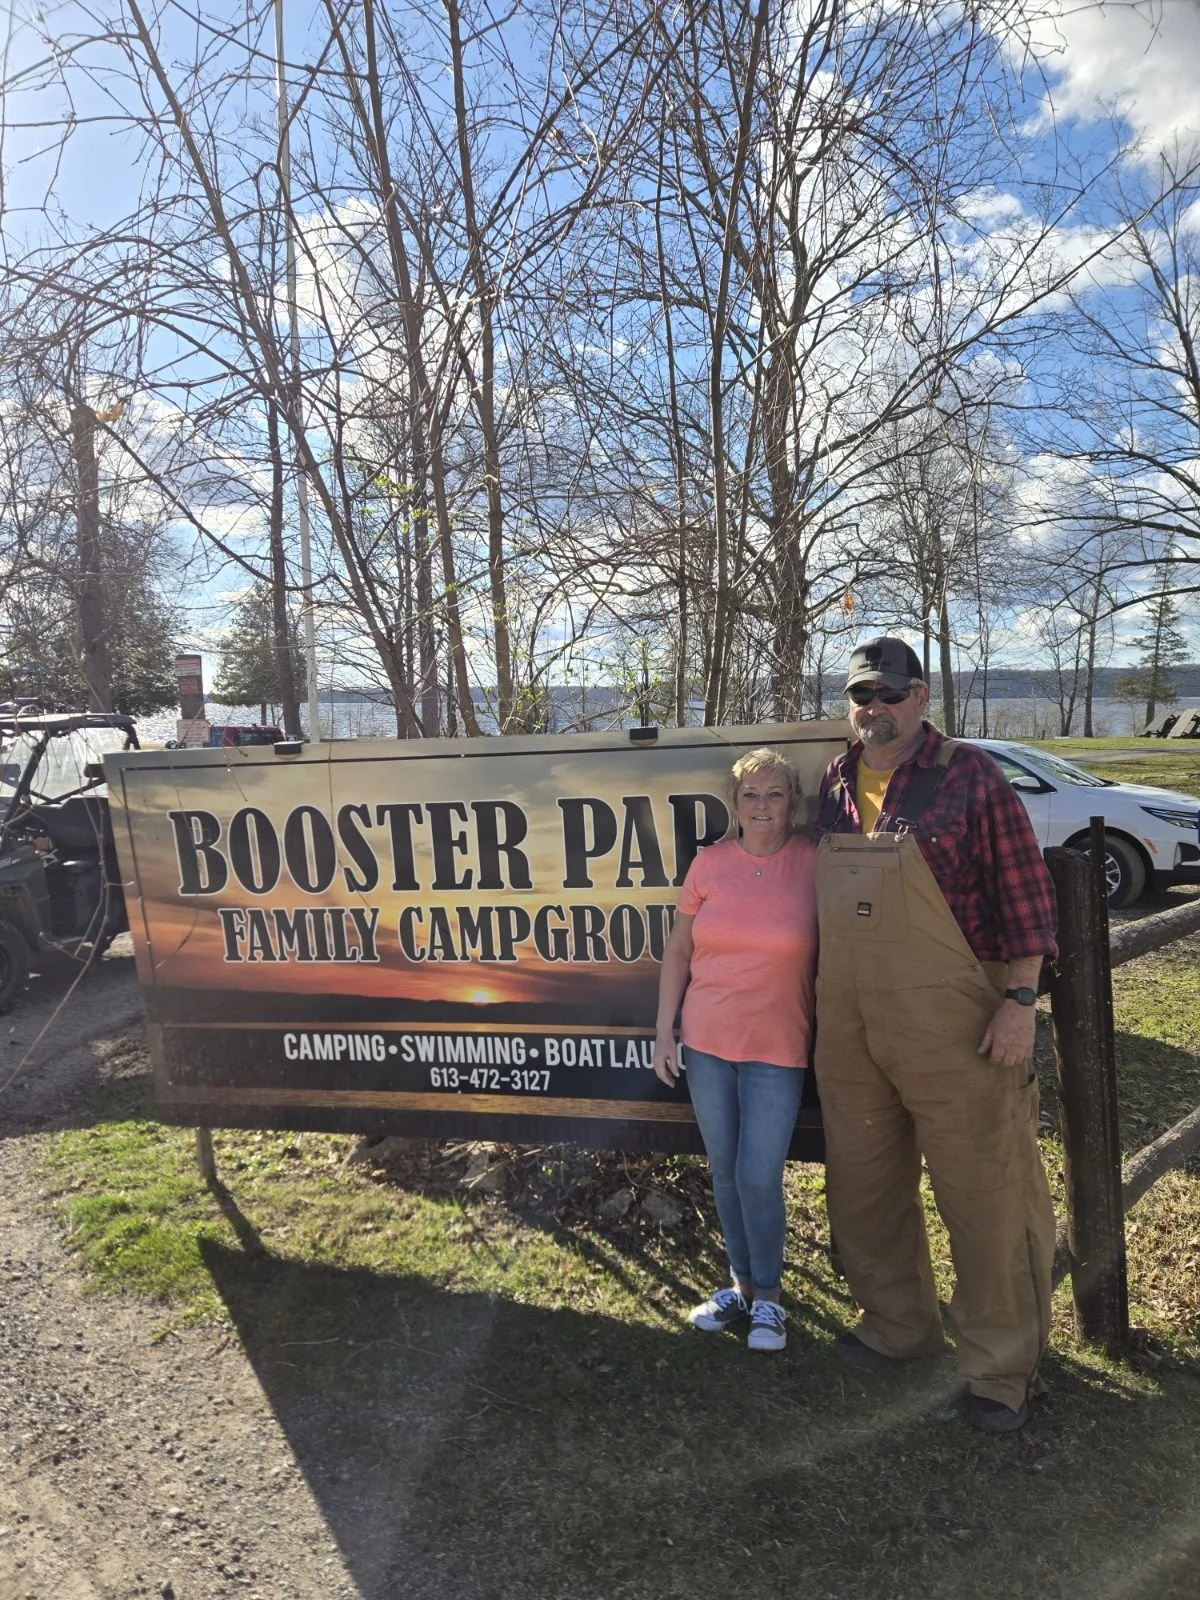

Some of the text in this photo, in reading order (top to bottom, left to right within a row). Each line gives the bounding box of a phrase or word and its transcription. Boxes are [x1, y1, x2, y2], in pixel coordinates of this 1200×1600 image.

[168, 793, 731, 896] BOOSTER PAR
[218, 903, 677, 964] FAMILY CAMPGROU
[283, 1033, 385, 1061] CAMPING
[400, 1035, 526, 1065] SWIMMING
[431, 1067, 550, 1091] 613-472-3127
